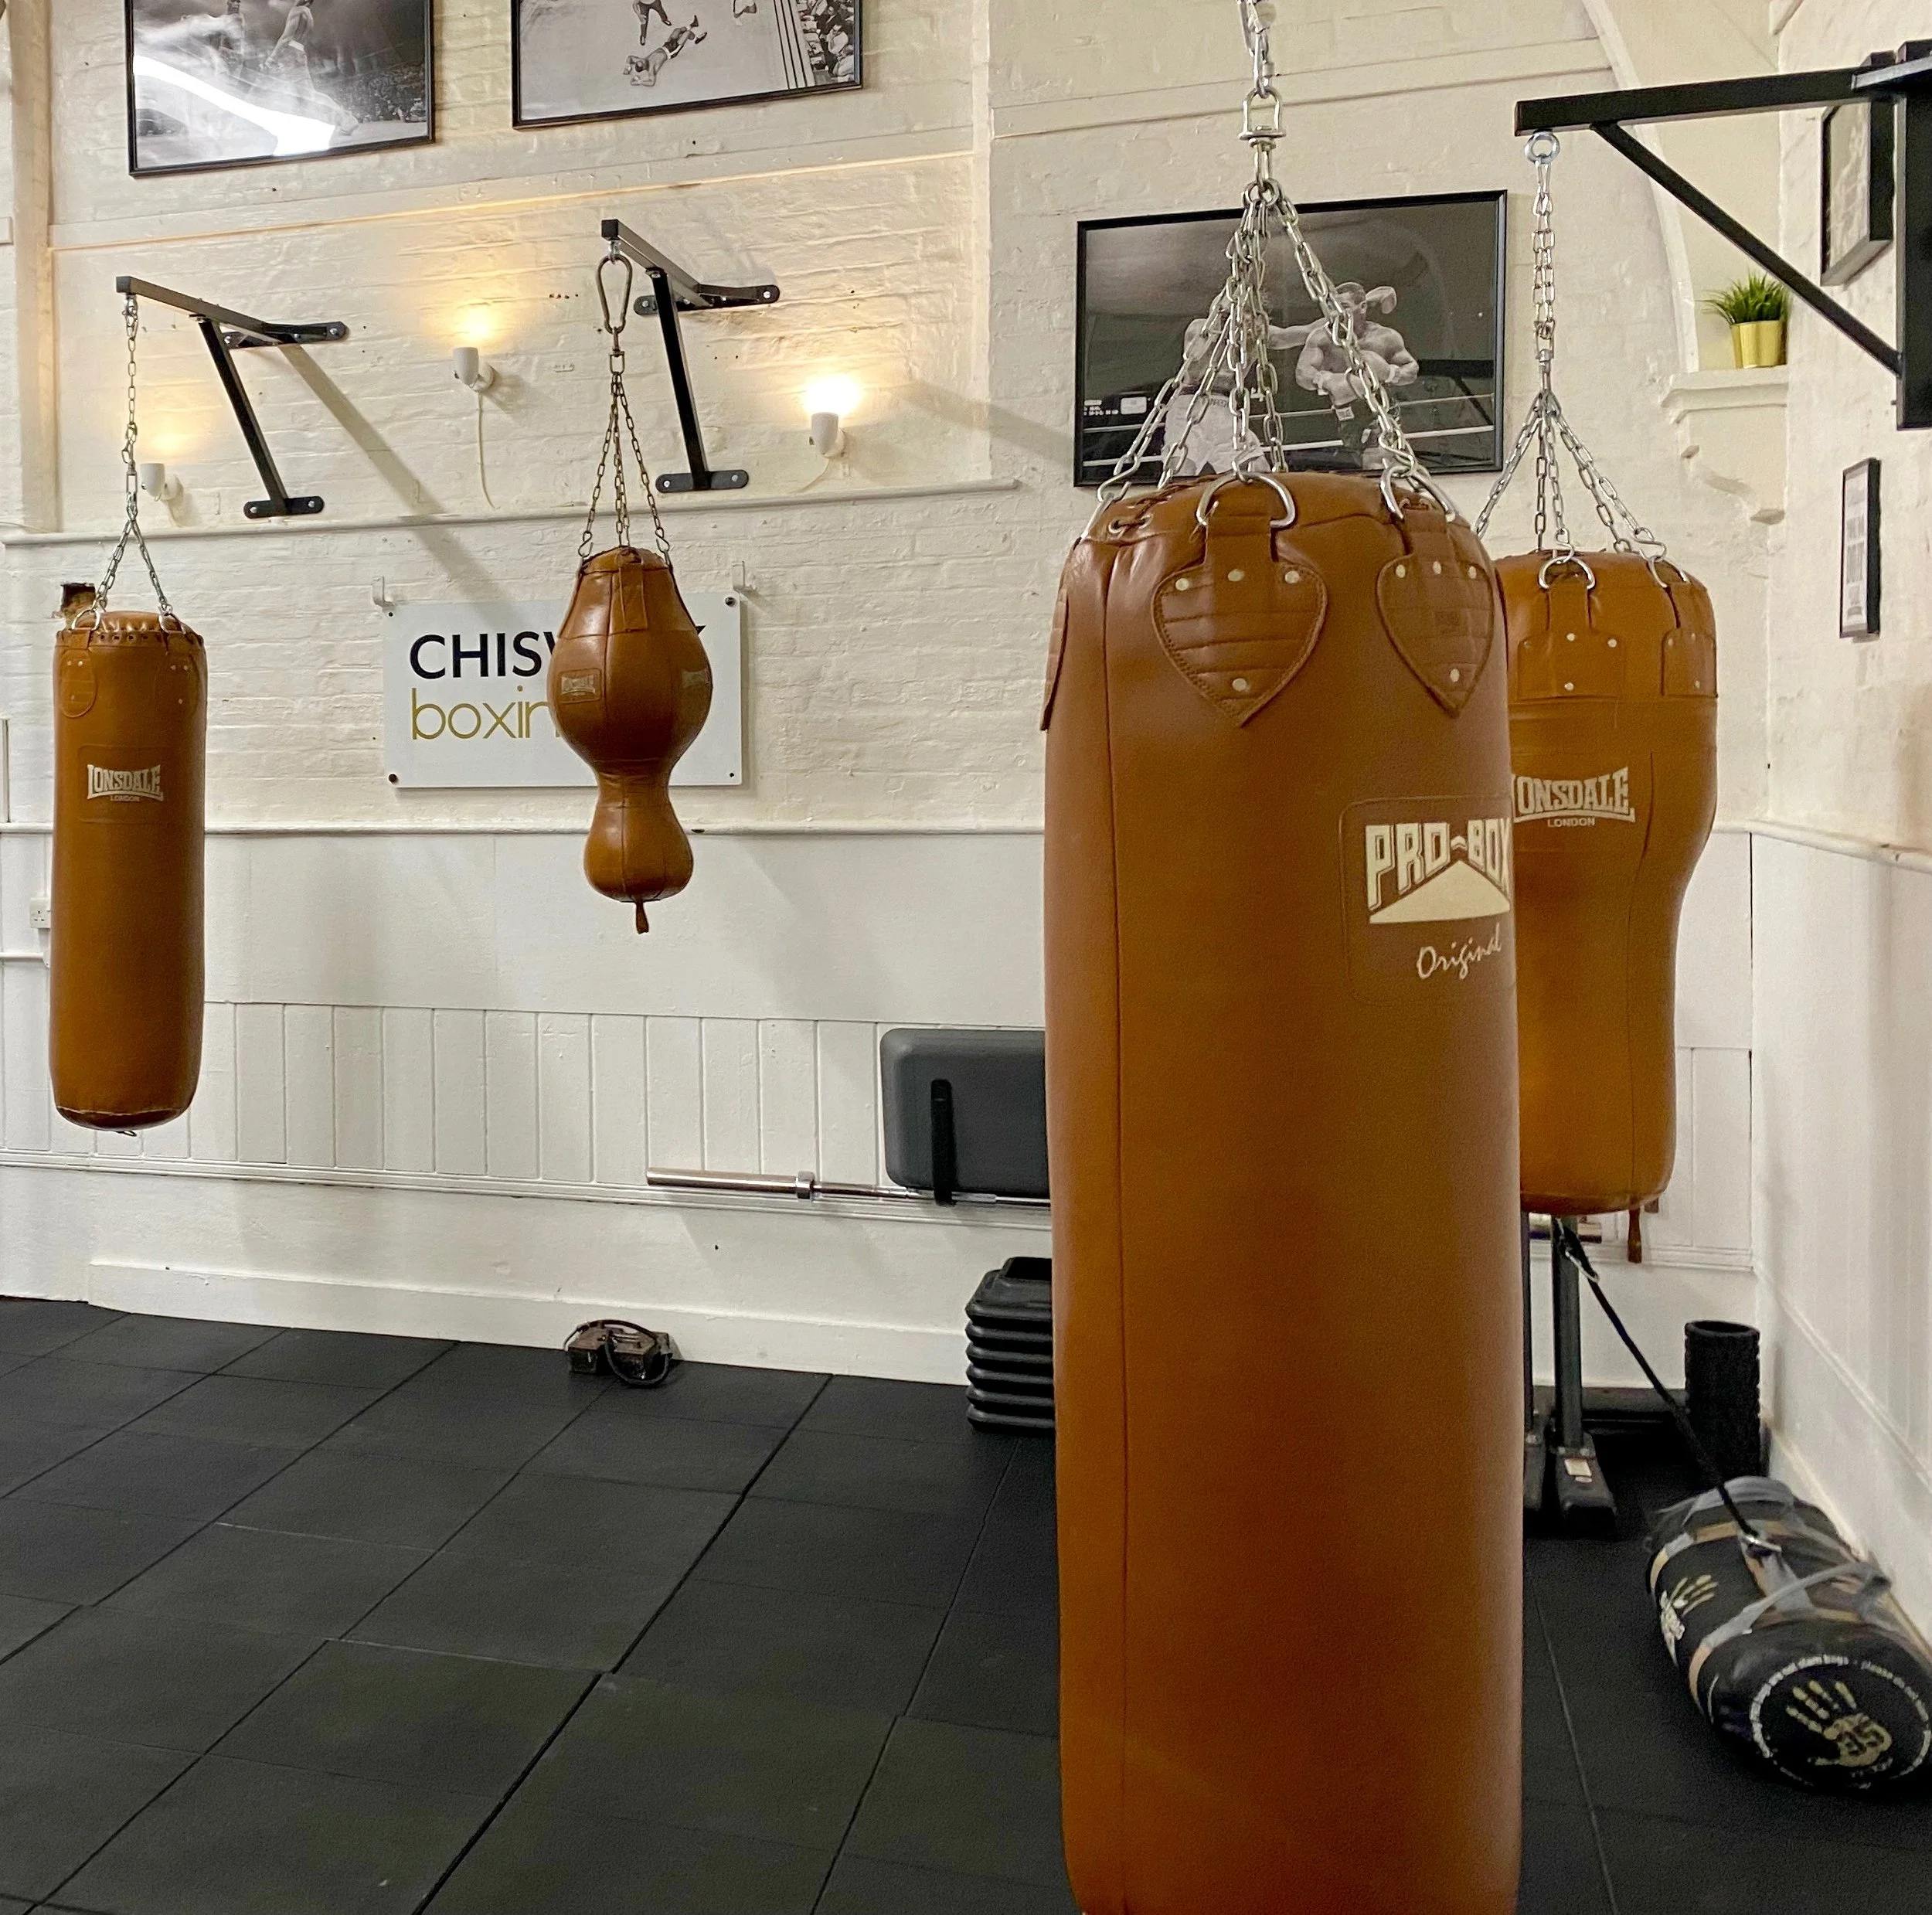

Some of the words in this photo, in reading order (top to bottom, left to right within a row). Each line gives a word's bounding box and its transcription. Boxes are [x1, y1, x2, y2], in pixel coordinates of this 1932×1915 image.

[411, 685, 560, 740] boxin
[87, 764, 164, 801] LONSDALE
[1548, 818, 1596, 828] LONDON
[1417, 922, 1502, 979] Original
